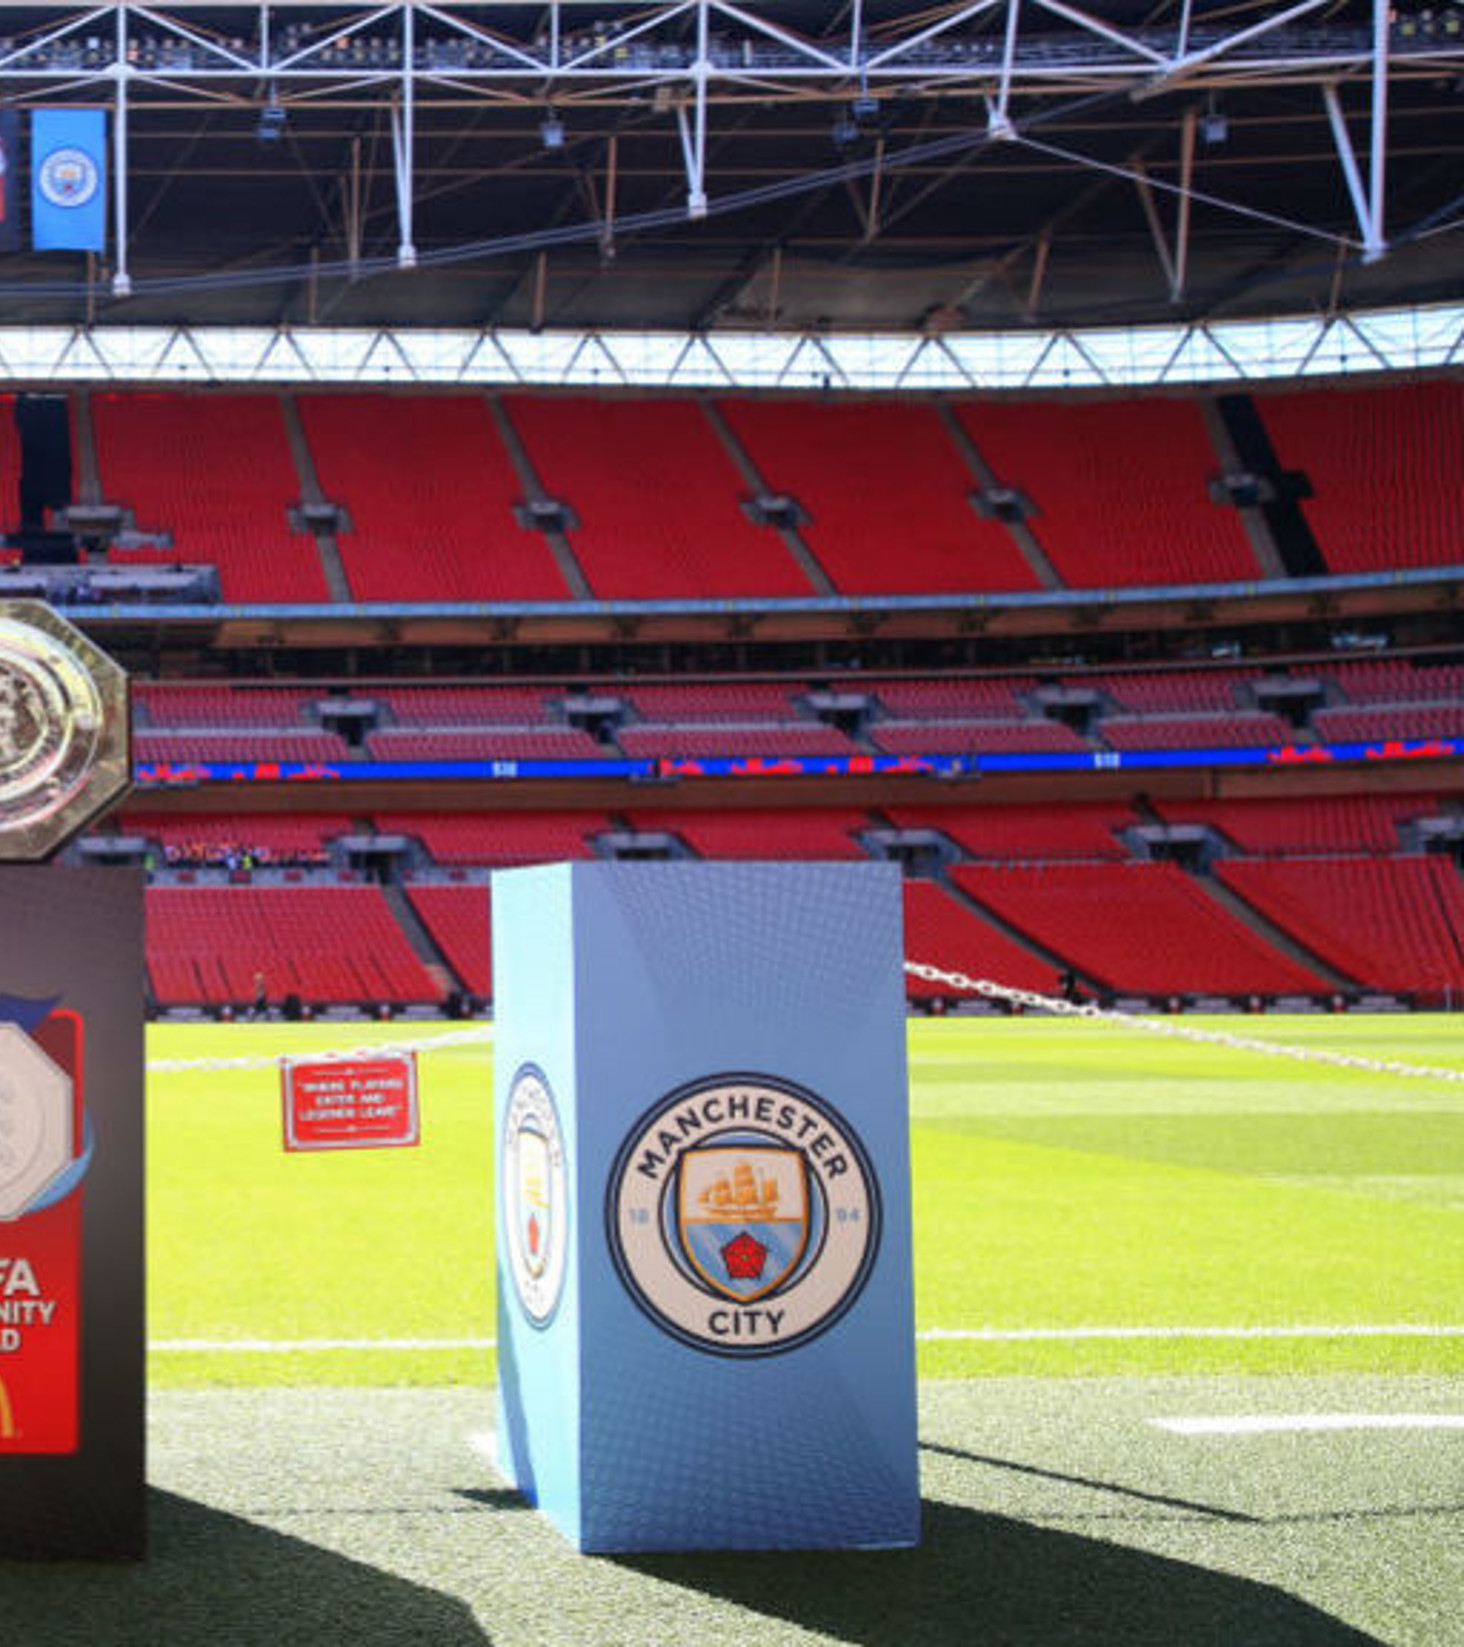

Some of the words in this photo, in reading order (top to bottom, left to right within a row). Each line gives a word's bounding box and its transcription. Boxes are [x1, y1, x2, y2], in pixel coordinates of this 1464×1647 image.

[636, 1096, 849, 1180] MANCHESTER
[836, 1207, 860, 1223] 94
[708, 1310, 786, 1336] CITY
